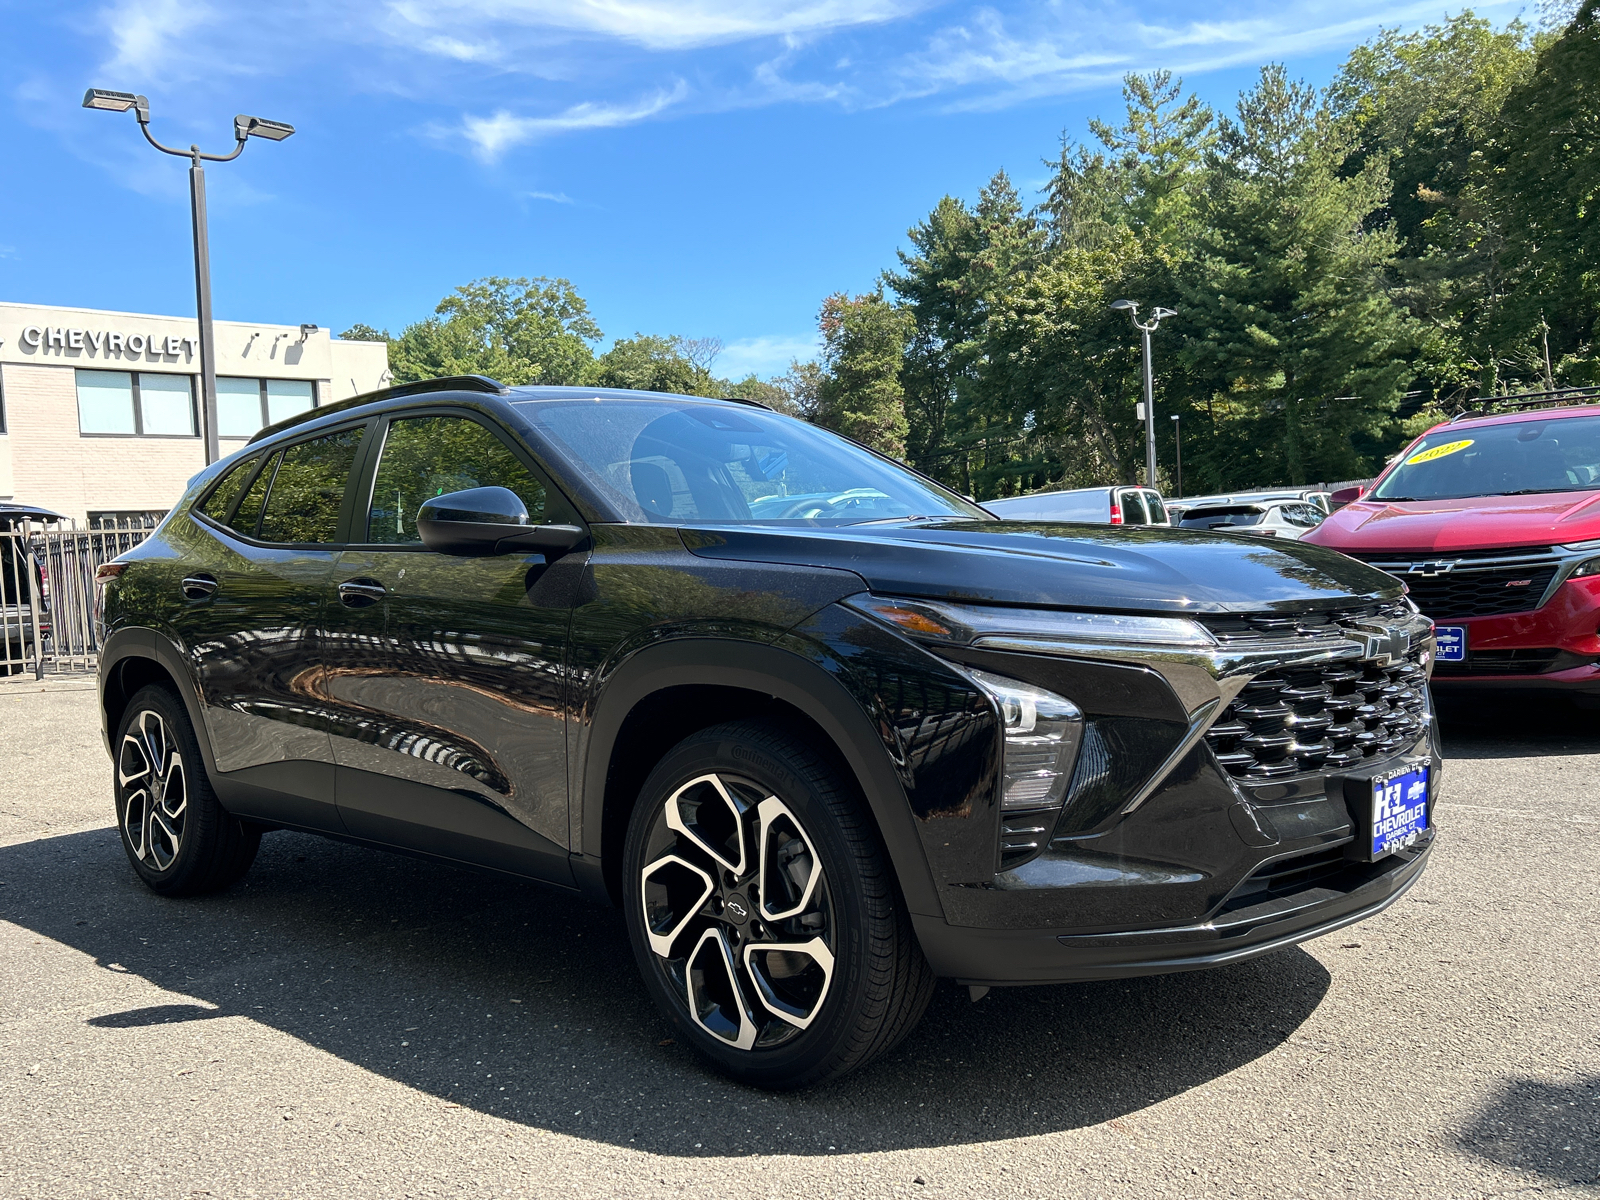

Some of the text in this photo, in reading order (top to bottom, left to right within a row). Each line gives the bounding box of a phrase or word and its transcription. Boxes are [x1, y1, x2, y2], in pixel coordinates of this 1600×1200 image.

[23, 325, 198, 356] CHEVROLET
[1418, 442, 1462, 462] 2022
[731, 745, 788, 782] Continental
[1373, 783, 1406, 823] H&L
[1373, 802, 1426, 838] CHEVROLET
